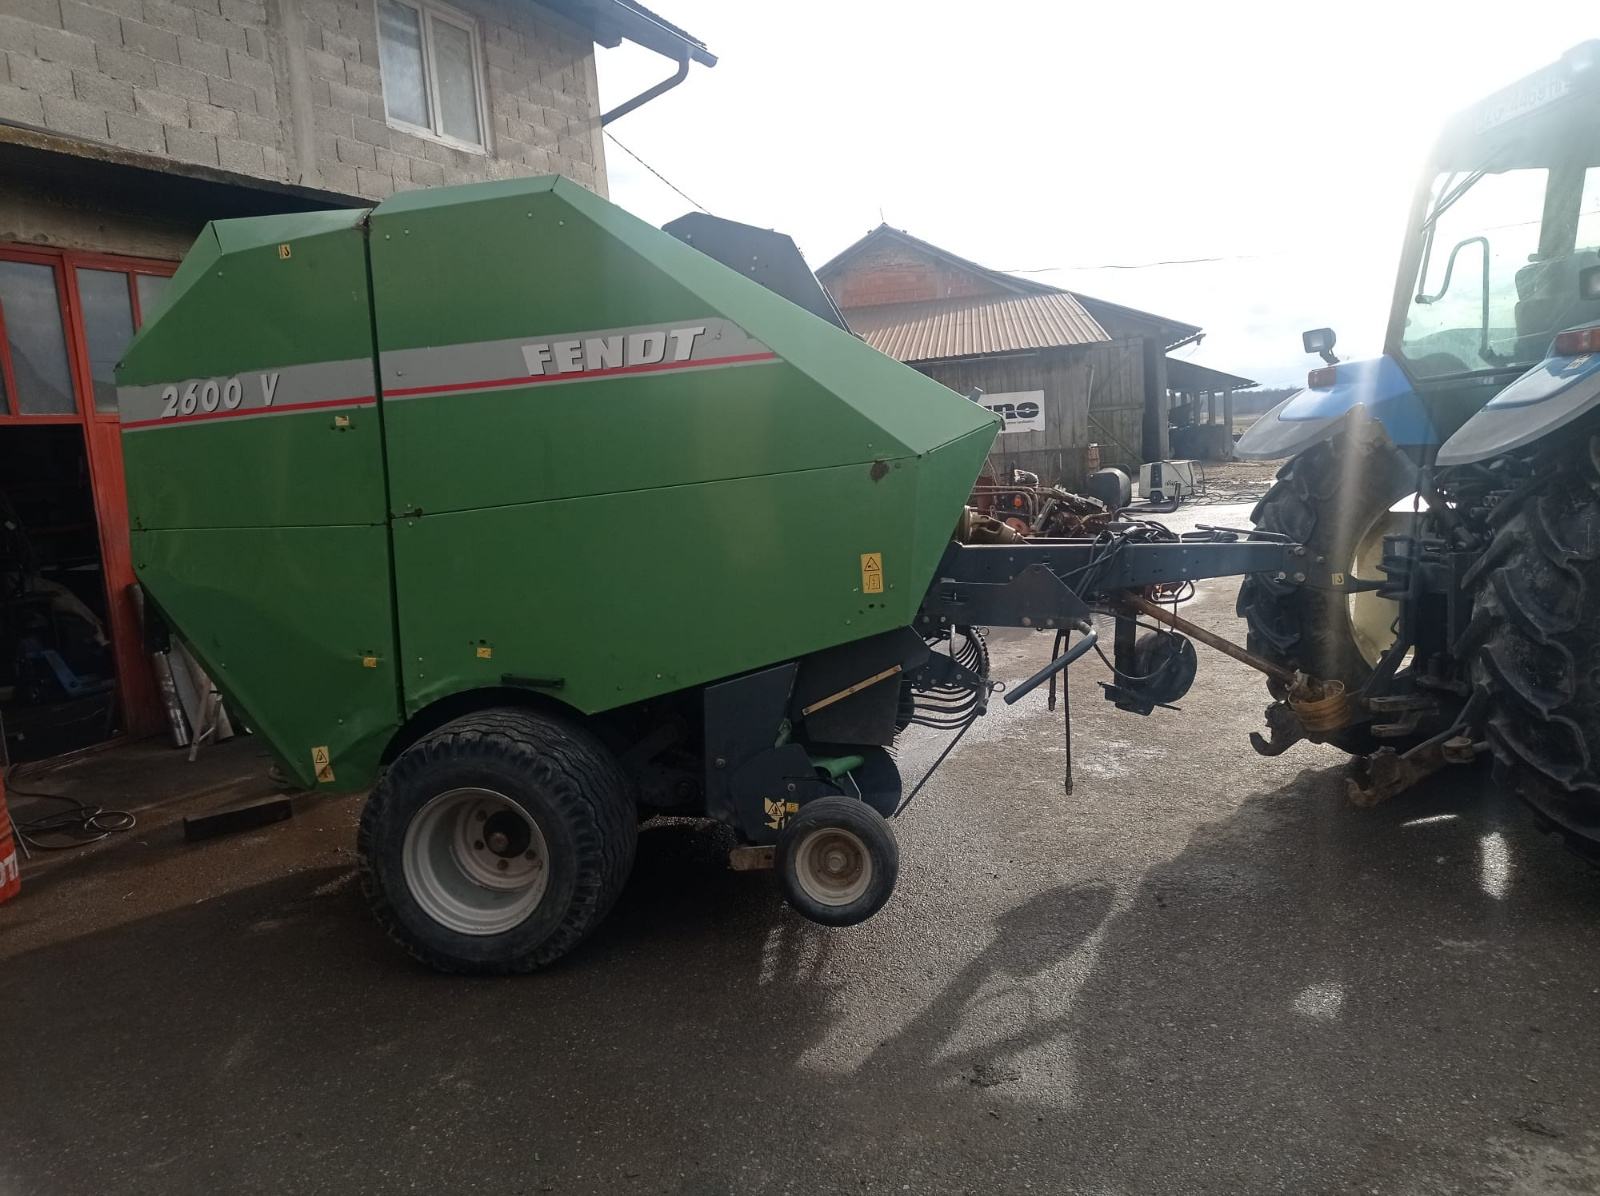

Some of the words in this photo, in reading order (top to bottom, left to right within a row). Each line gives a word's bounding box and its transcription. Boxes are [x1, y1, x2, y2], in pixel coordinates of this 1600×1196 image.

[521, 326, 706, 376] FENDT
[161, 377, 244, 419] 2600
[260, 372, 279, 407] V
